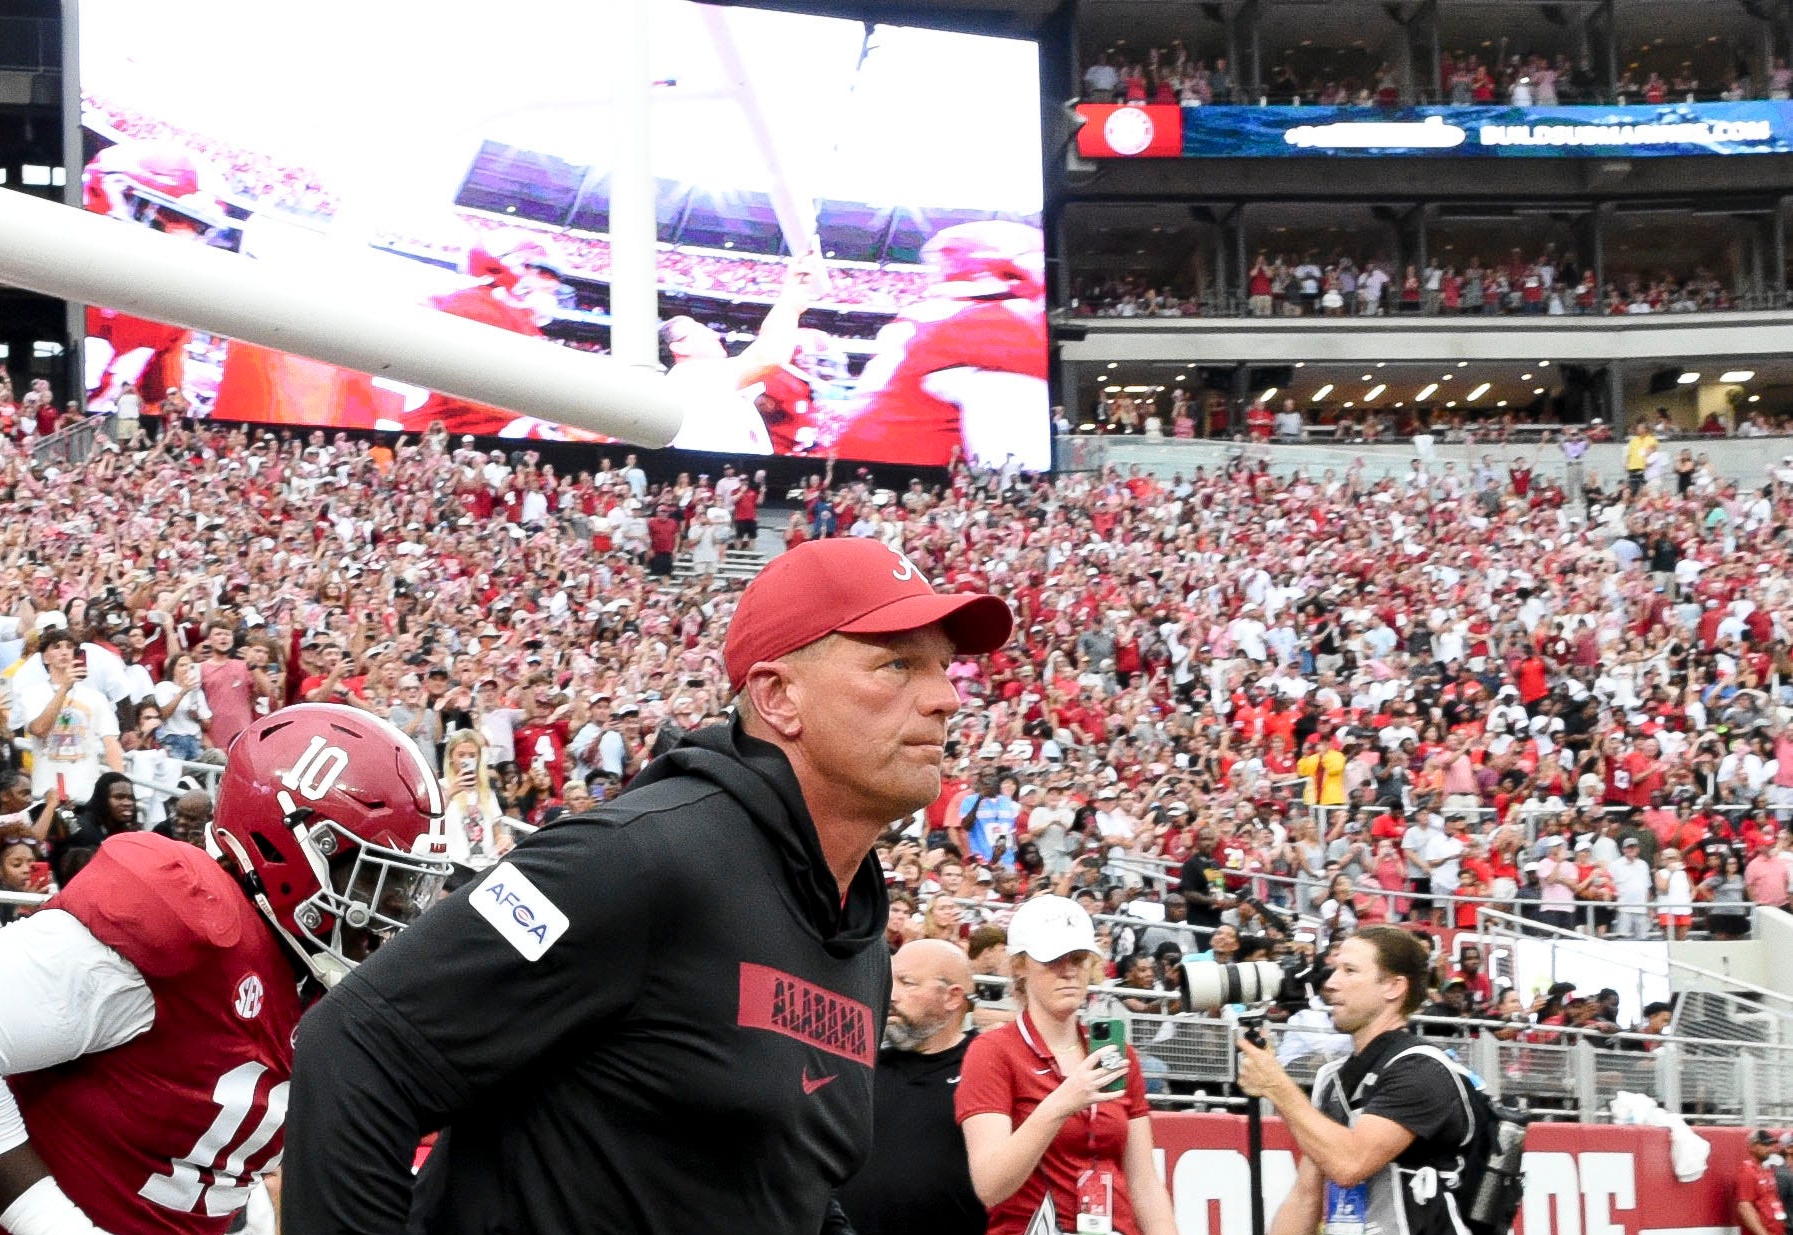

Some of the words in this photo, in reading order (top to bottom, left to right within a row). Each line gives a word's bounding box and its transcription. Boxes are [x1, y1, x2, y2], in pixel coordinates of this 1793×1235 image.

[281, 735, 349, 801] 10
[486, 883, 547, 944] AFCA
[236, 976, 263, 1018] SEC
[772, 977, 866, 1059] ALABAMA
